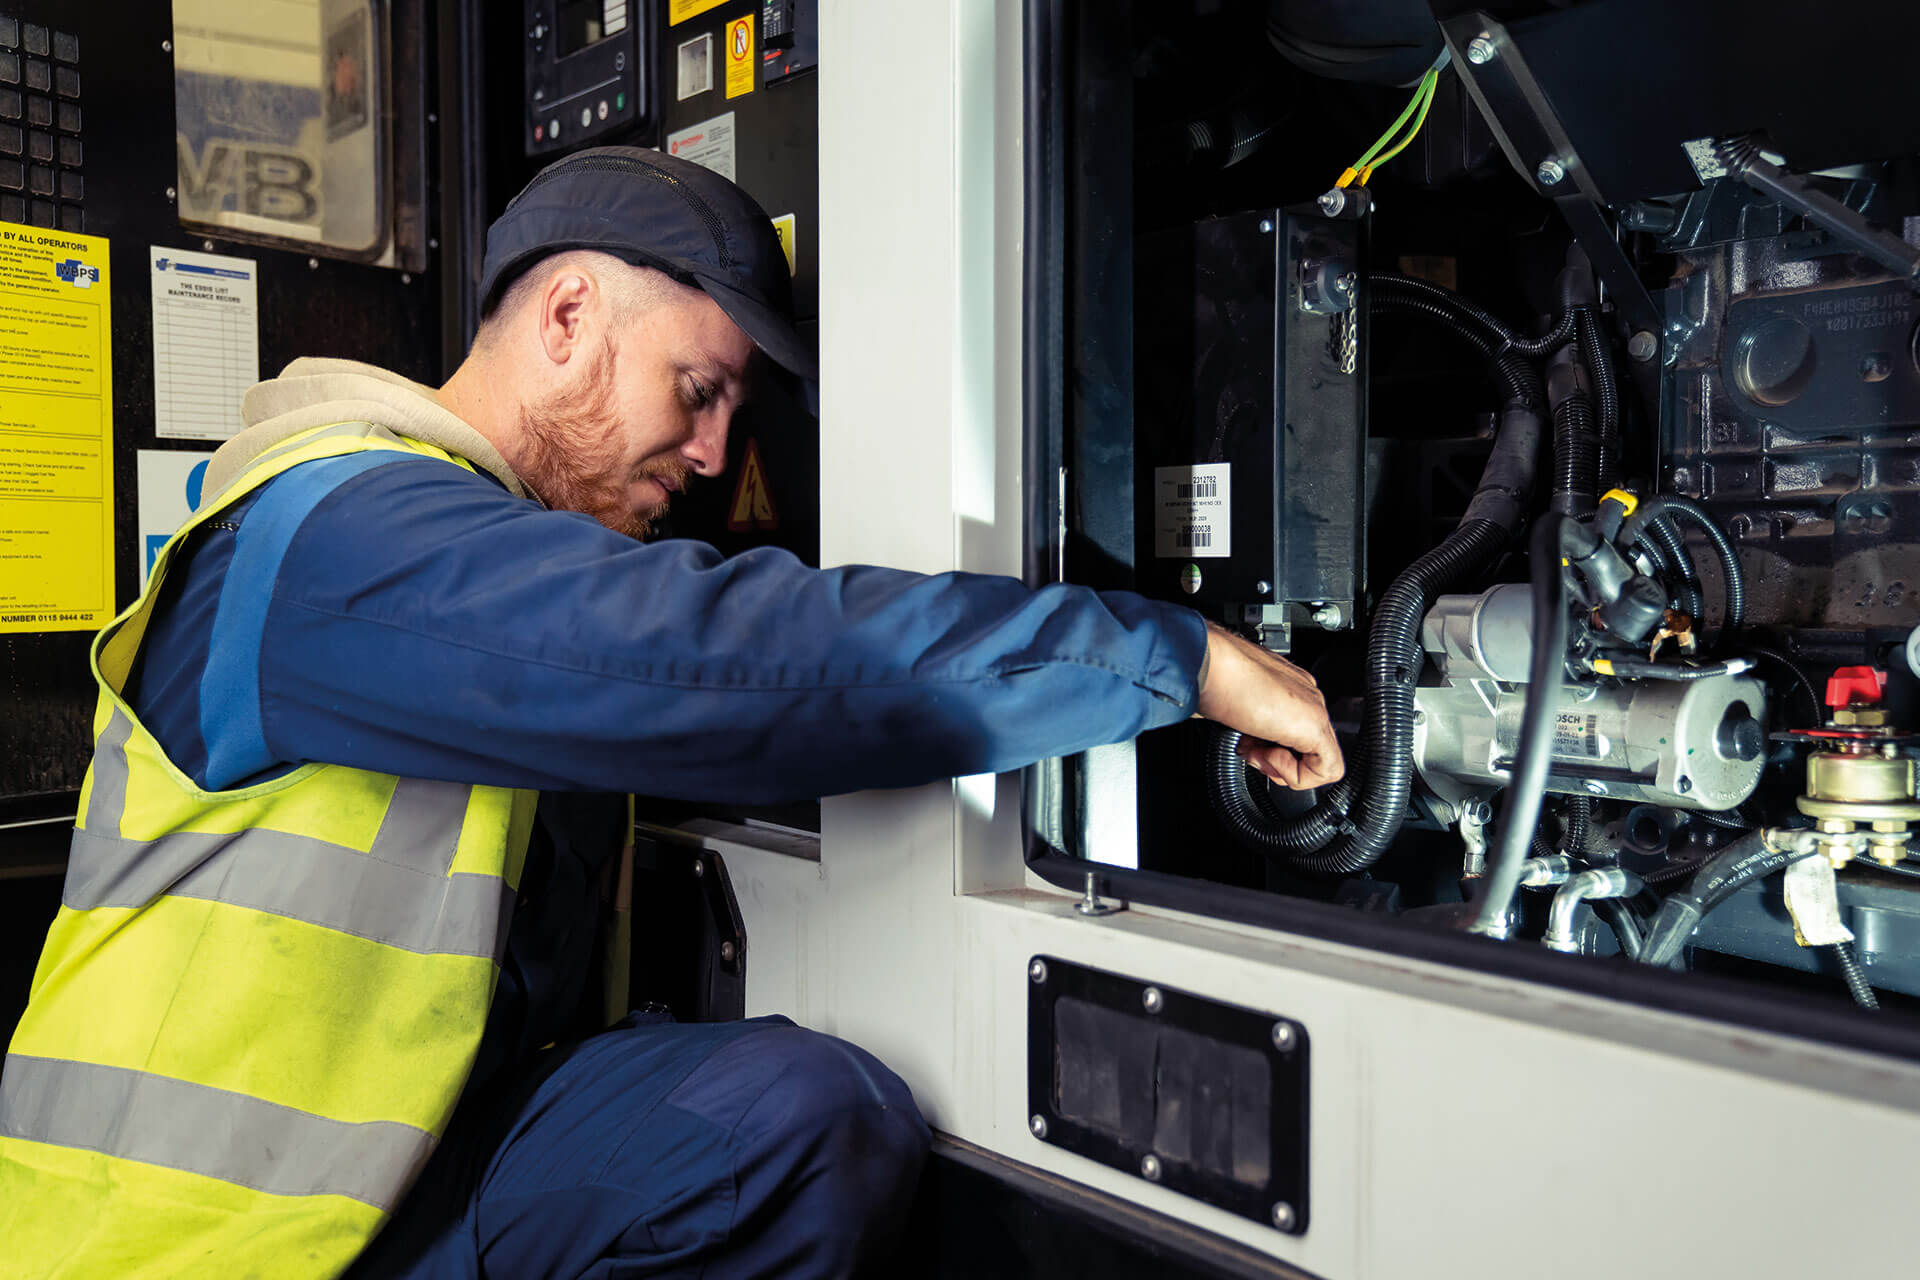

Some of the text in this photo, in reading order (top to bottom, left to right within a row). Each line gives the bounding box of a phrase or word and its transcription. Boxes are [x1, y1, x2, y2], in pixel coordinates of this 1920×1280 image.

[4, 232, 88, 252] BY ALL OPERATORS
[59, 263, 96, 280] WBPS
[180, 282, 193, 290] THE
[215, 286, 229, 294] LIST
[168, 289, 241, 304] MAINTENANCE RECORD
[1, 613, 94, 623] NUMBER 0115 9444 422
